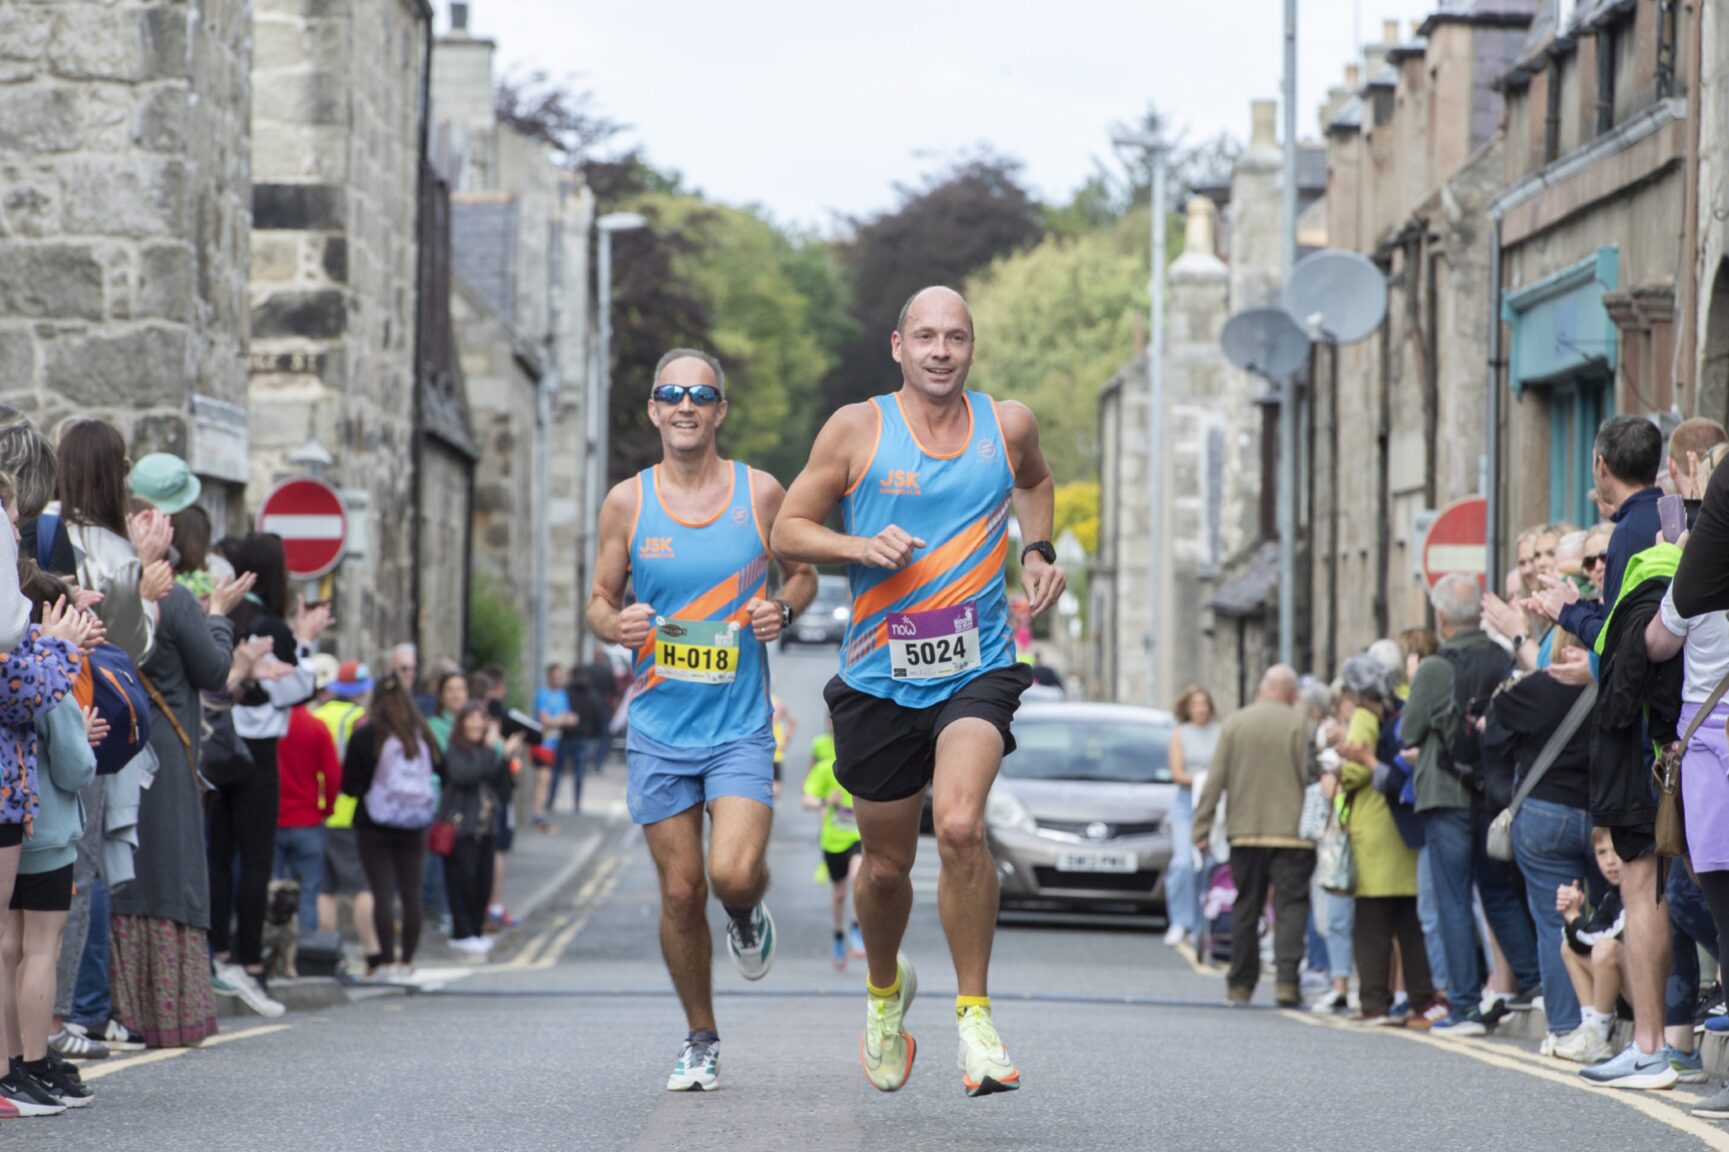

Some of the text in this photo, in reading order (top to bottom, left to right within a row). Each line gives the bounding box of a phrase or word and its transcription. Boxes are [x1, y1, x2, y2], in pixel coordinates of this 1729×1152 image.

[880, 469, 919, 488] JSK
[640, 537, 672, 552] JSK
[891, 620, 917, 636] now
[664, 644, 728, 671] H-018
[905, 636, 966, 666] 5024
